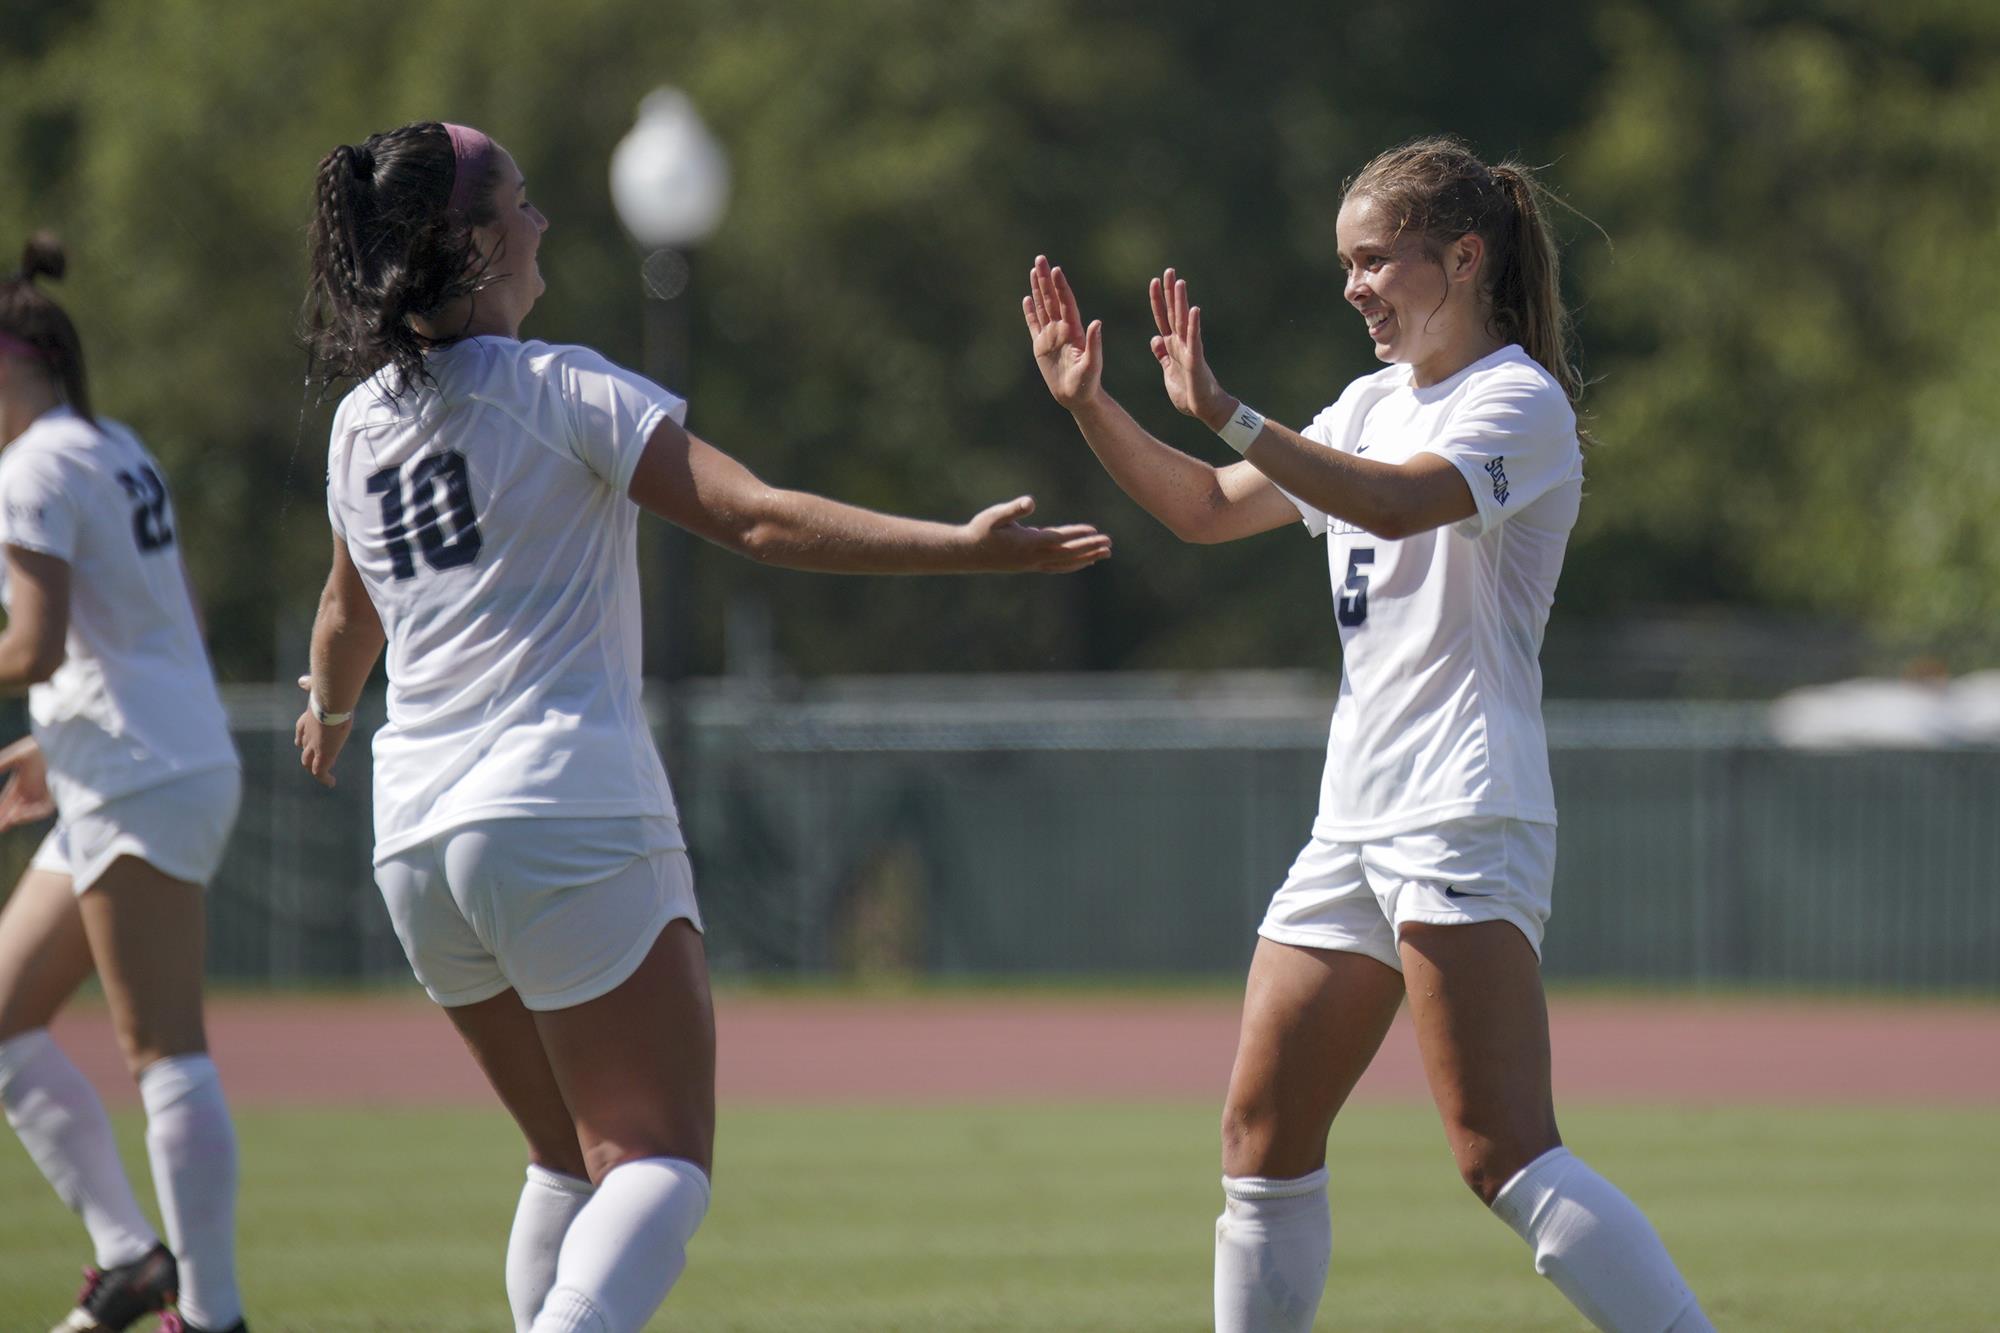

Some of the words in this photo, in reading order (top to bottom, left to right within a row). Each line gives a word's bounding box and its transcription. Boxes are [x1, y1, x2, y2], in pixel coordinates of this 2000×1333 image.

[116, 464, 173, 553] 22
[366, 450, 482, 581] 10
[1338, 548, 1375, 627] 5
